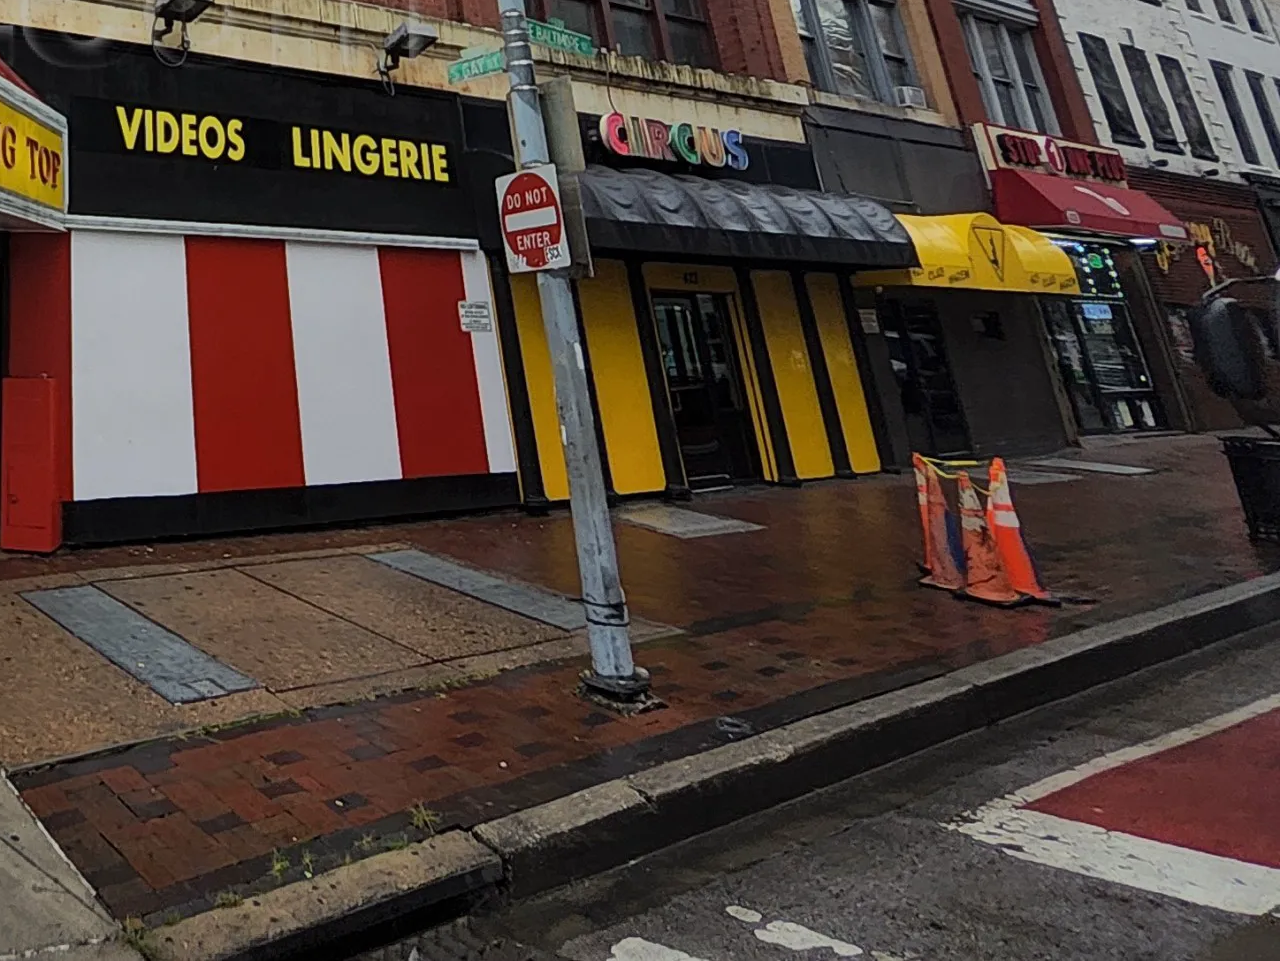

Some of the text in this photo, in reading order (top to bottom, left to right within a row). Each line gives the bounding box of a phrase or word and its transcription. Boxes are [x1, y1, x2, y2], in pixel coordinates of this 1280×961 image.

[462, 57, 485, 79] GAY
[116, 106, 450, 183] VIDEOS LINGERIE
[600, 112, 749, 171] CIRCUS
[25, 135, 62, 189] TOP
[506, 186, 548, 210] DO NOT
[516, 231, 552, 251] ENTER
